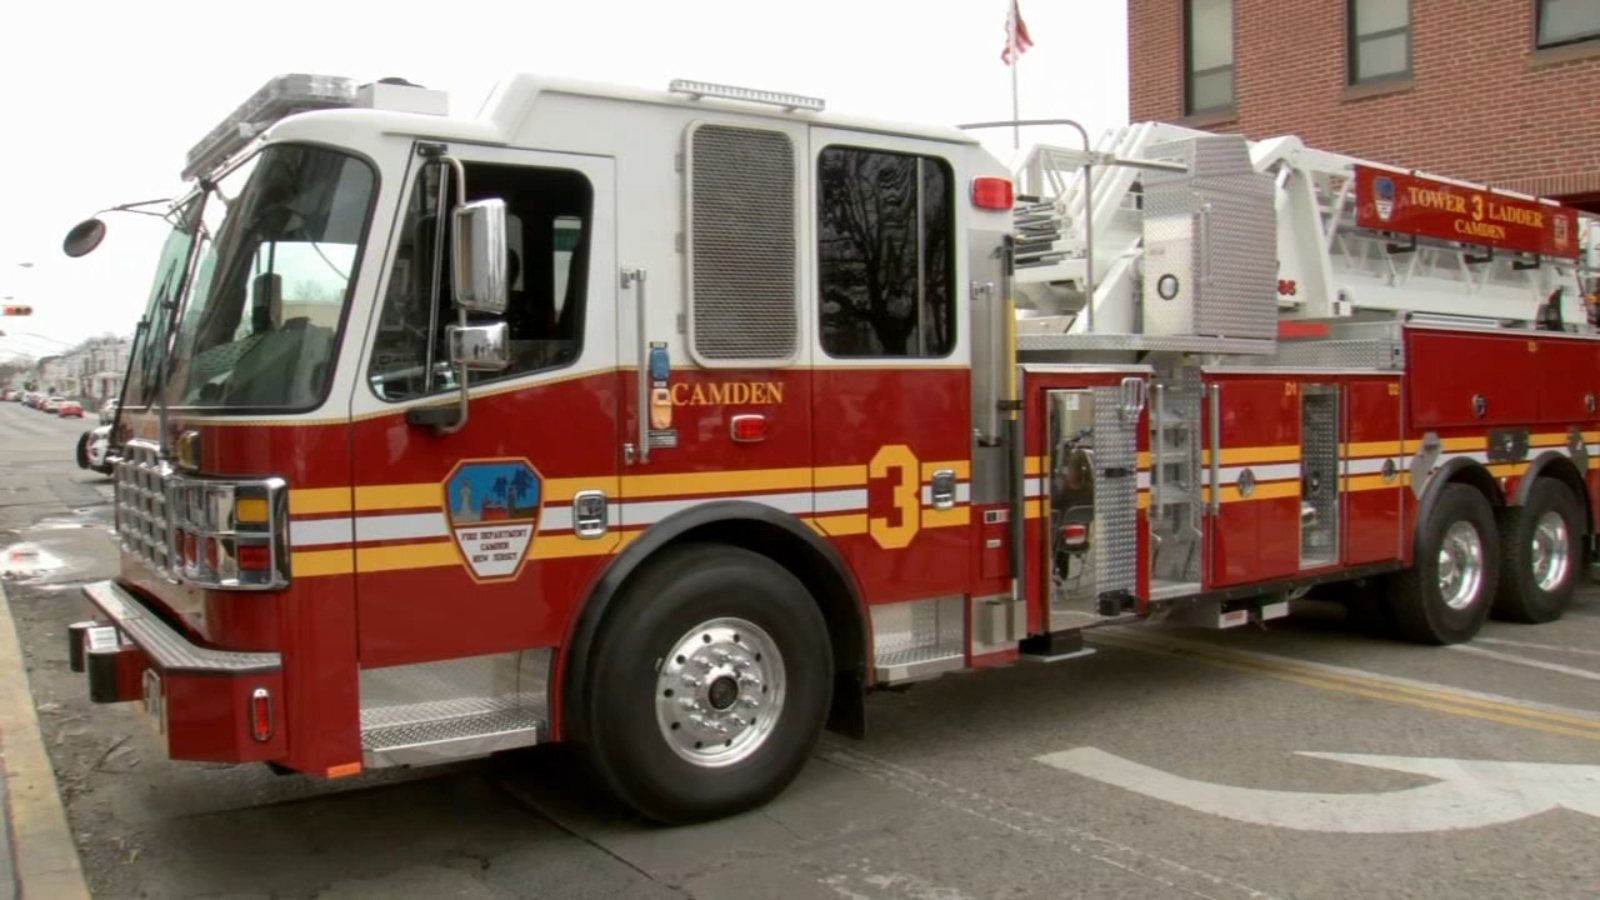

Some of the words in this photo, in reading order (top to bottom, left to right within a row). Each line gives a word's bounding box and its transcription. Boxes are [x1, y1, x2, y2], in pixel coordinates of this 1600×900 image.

[1408, 187, 1466, 213] TOWER
[1471, 194, 1484, 221] 3
[1489, 202, 1544, 228] LADDER
[1454, 218, 1506, 239] CAMDEN
[670, 382, 784, 406] CAMDEN
[869, 445, 919, 549] 3
[461, 532, 478, 541] FIRE
[480, 529, 527, 540] DEPARTMENT
